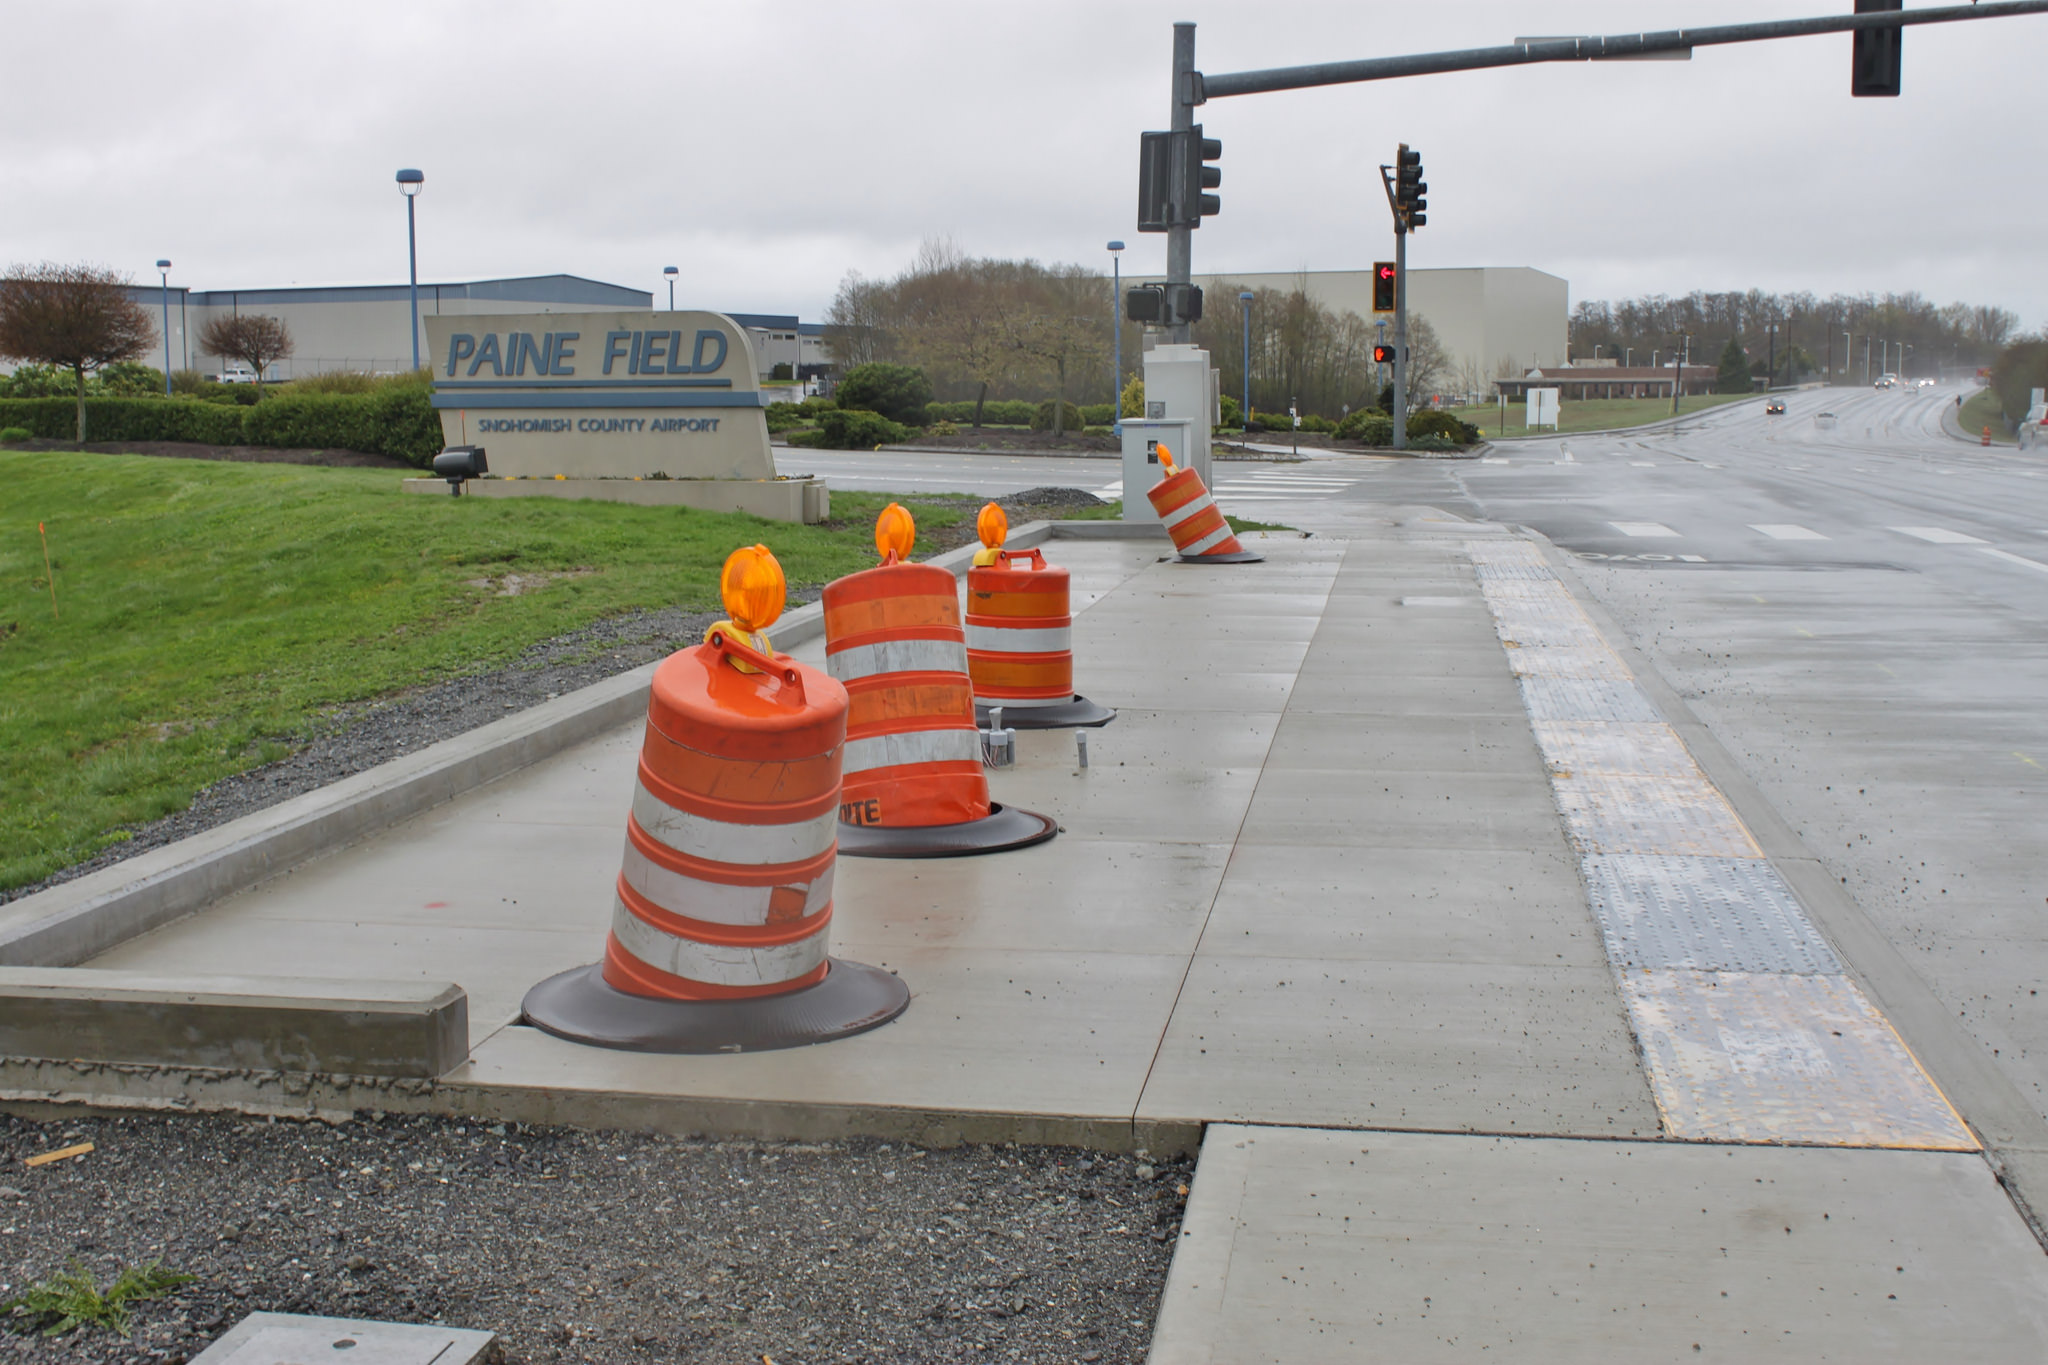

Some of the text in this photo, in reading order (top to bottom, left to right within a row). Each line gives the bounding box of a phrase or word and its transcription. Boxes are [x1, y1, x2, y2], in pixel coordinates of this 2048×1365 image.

[447, 330, 728, 376] PAINE FIELD
[478, 418, 720, 433] SNOHOMISH COUNTY AIRPORT
